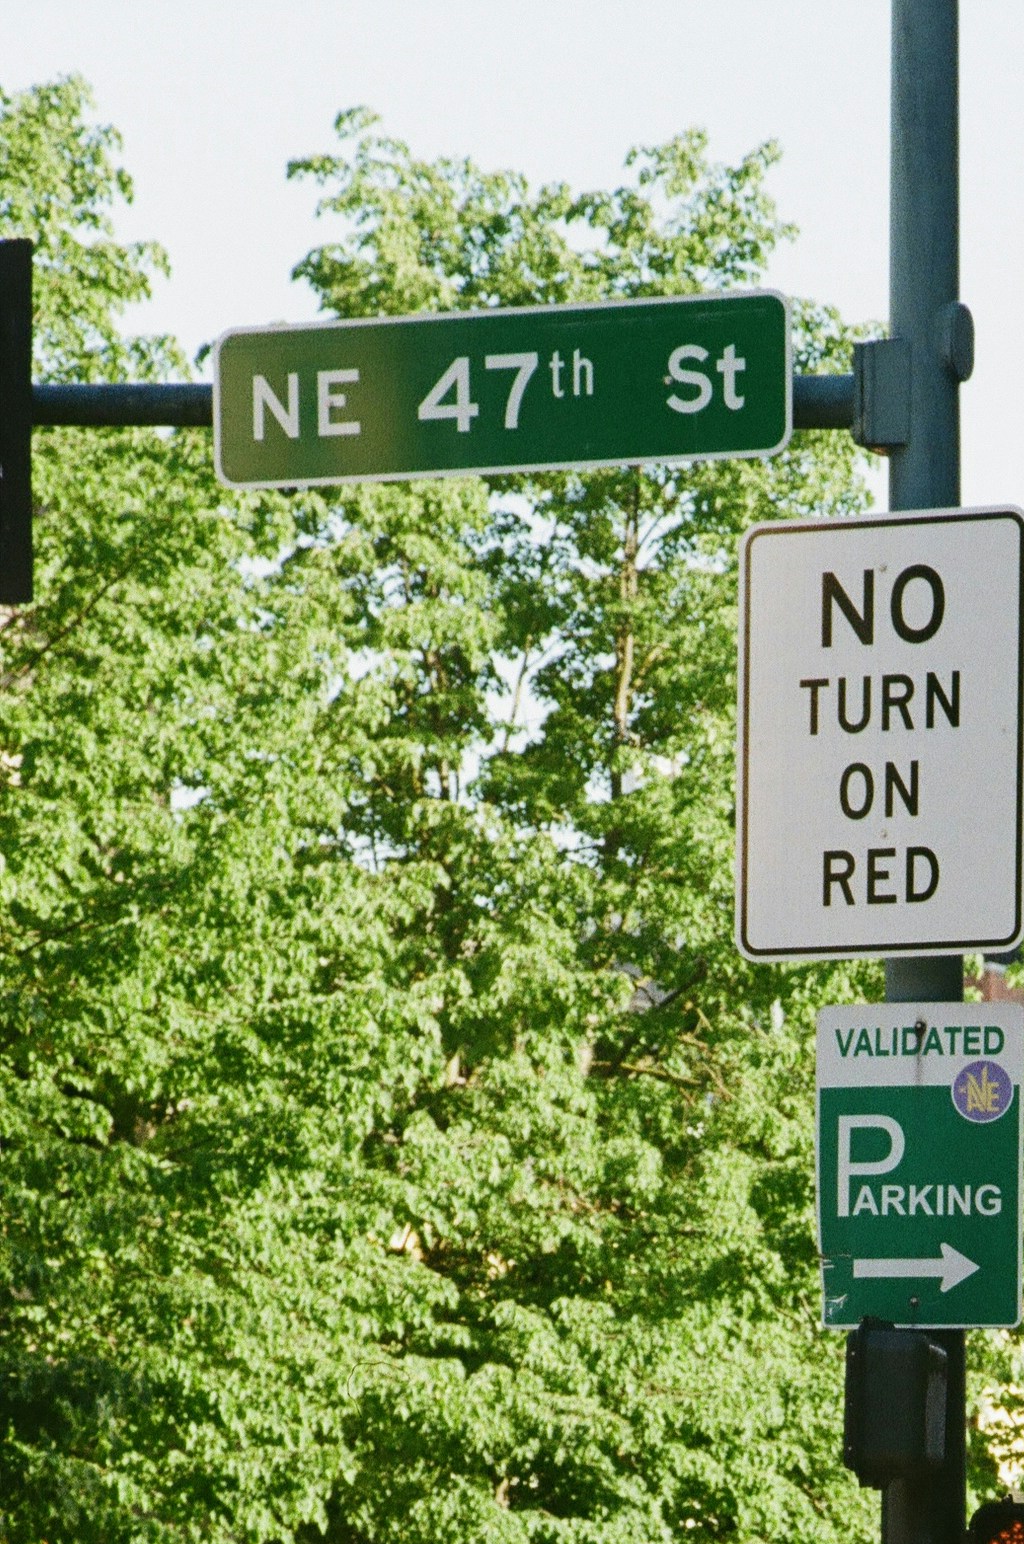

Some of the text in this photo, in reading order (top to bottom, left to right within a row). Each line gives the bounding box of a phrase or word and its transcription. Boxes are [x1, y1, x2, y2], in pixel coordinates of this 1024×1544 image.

[252, 343, 747, 441] NE 47th St
[821, 563, 945, 648] NO
[799, 670, 960, 735] TURN
[839, 760, 919, 821] ON
[822, 846, 940, 906] RED
[835, 1025, 1006, 1057] VALIDATED
[836, 1114, 1003, 1218] PARKING
